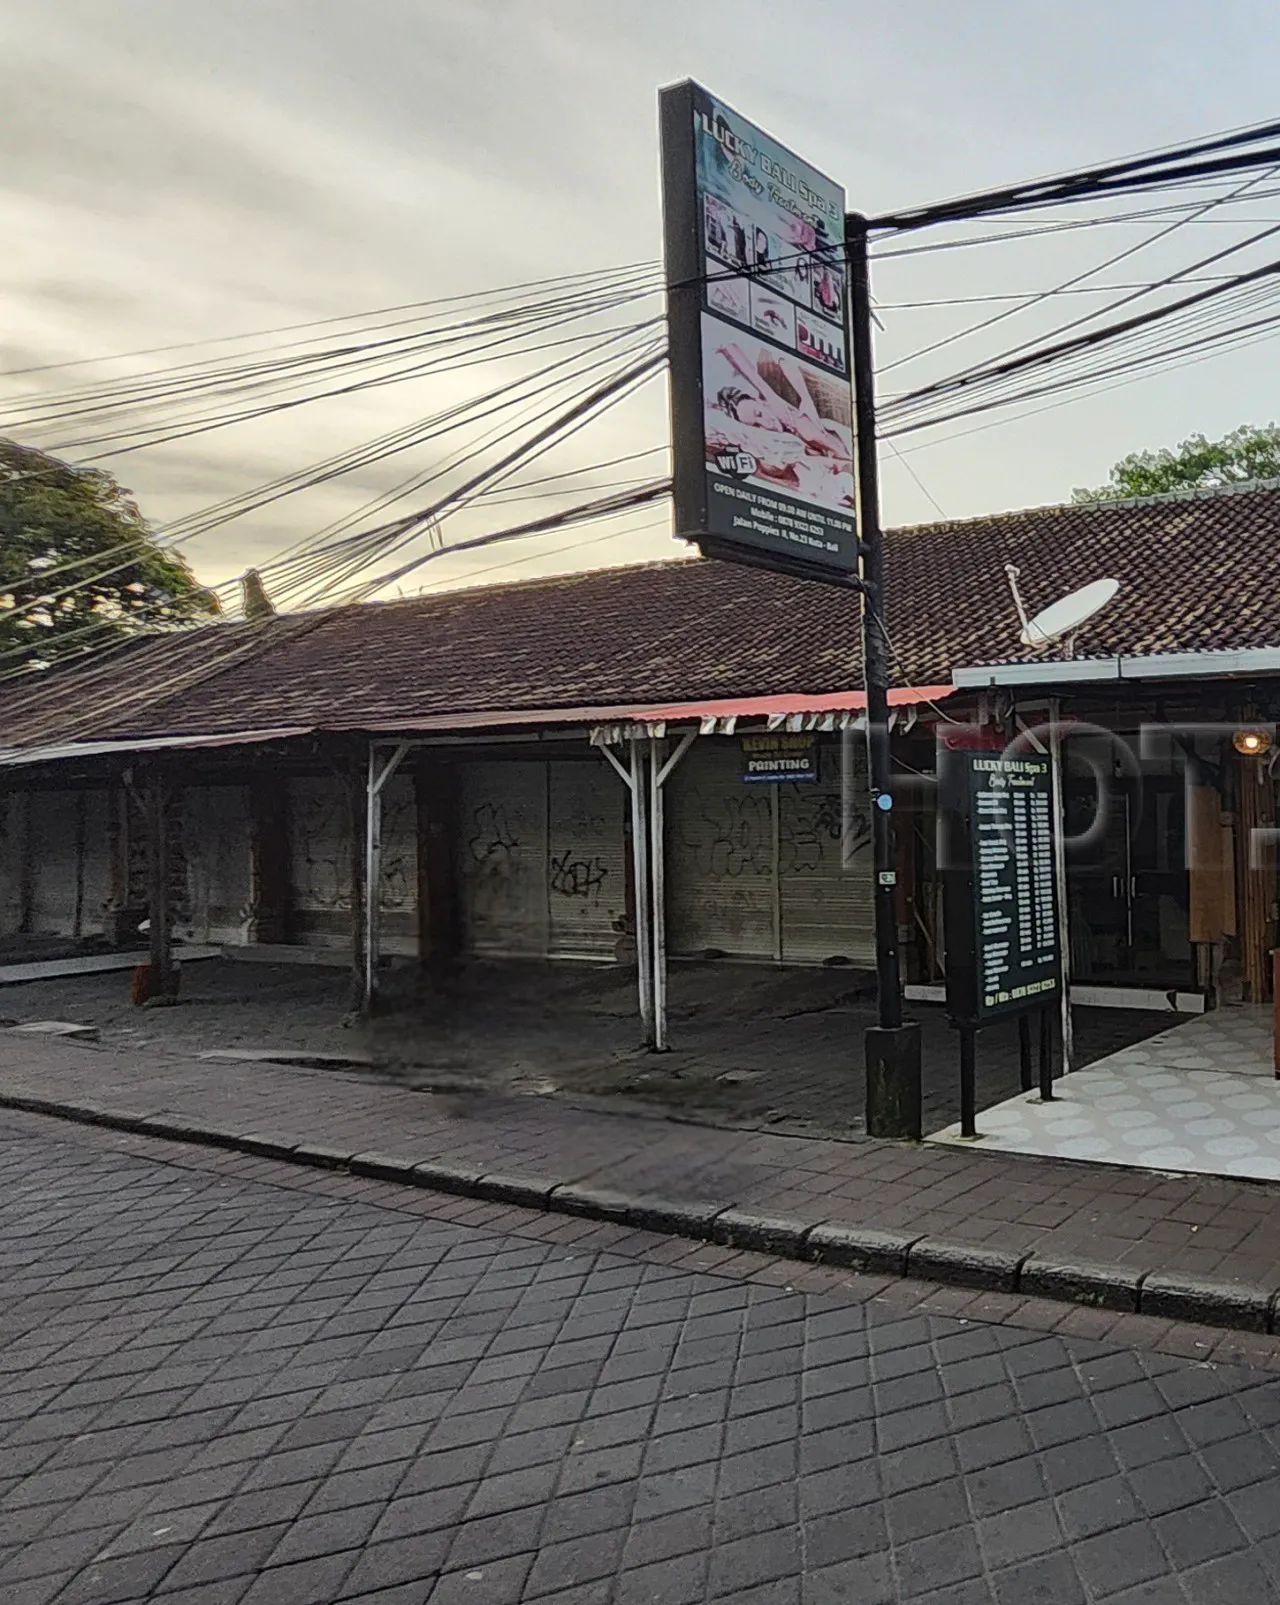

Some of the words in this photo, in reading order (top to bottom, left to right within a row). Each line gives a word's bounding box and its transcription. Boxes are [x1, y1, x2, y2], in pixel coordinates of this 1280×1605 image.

[702, 112, 759, 166] LUCKY
[760, 153, 796, 193] BALI
[798, 179, 826, 214] Spa
[828, 199, 840, 221] 3
[727, 158, 764, 199] Body
[713, 482, 735, 497] OPEN
[735, 488, 757, 503] DAILY
[748, 758, 810, 772] PAINTING
[972, 758, 1003, 772] LUCKY
[1003, 760, 1024, 773] BALI
[1040, 762, 1048, 774] 3
